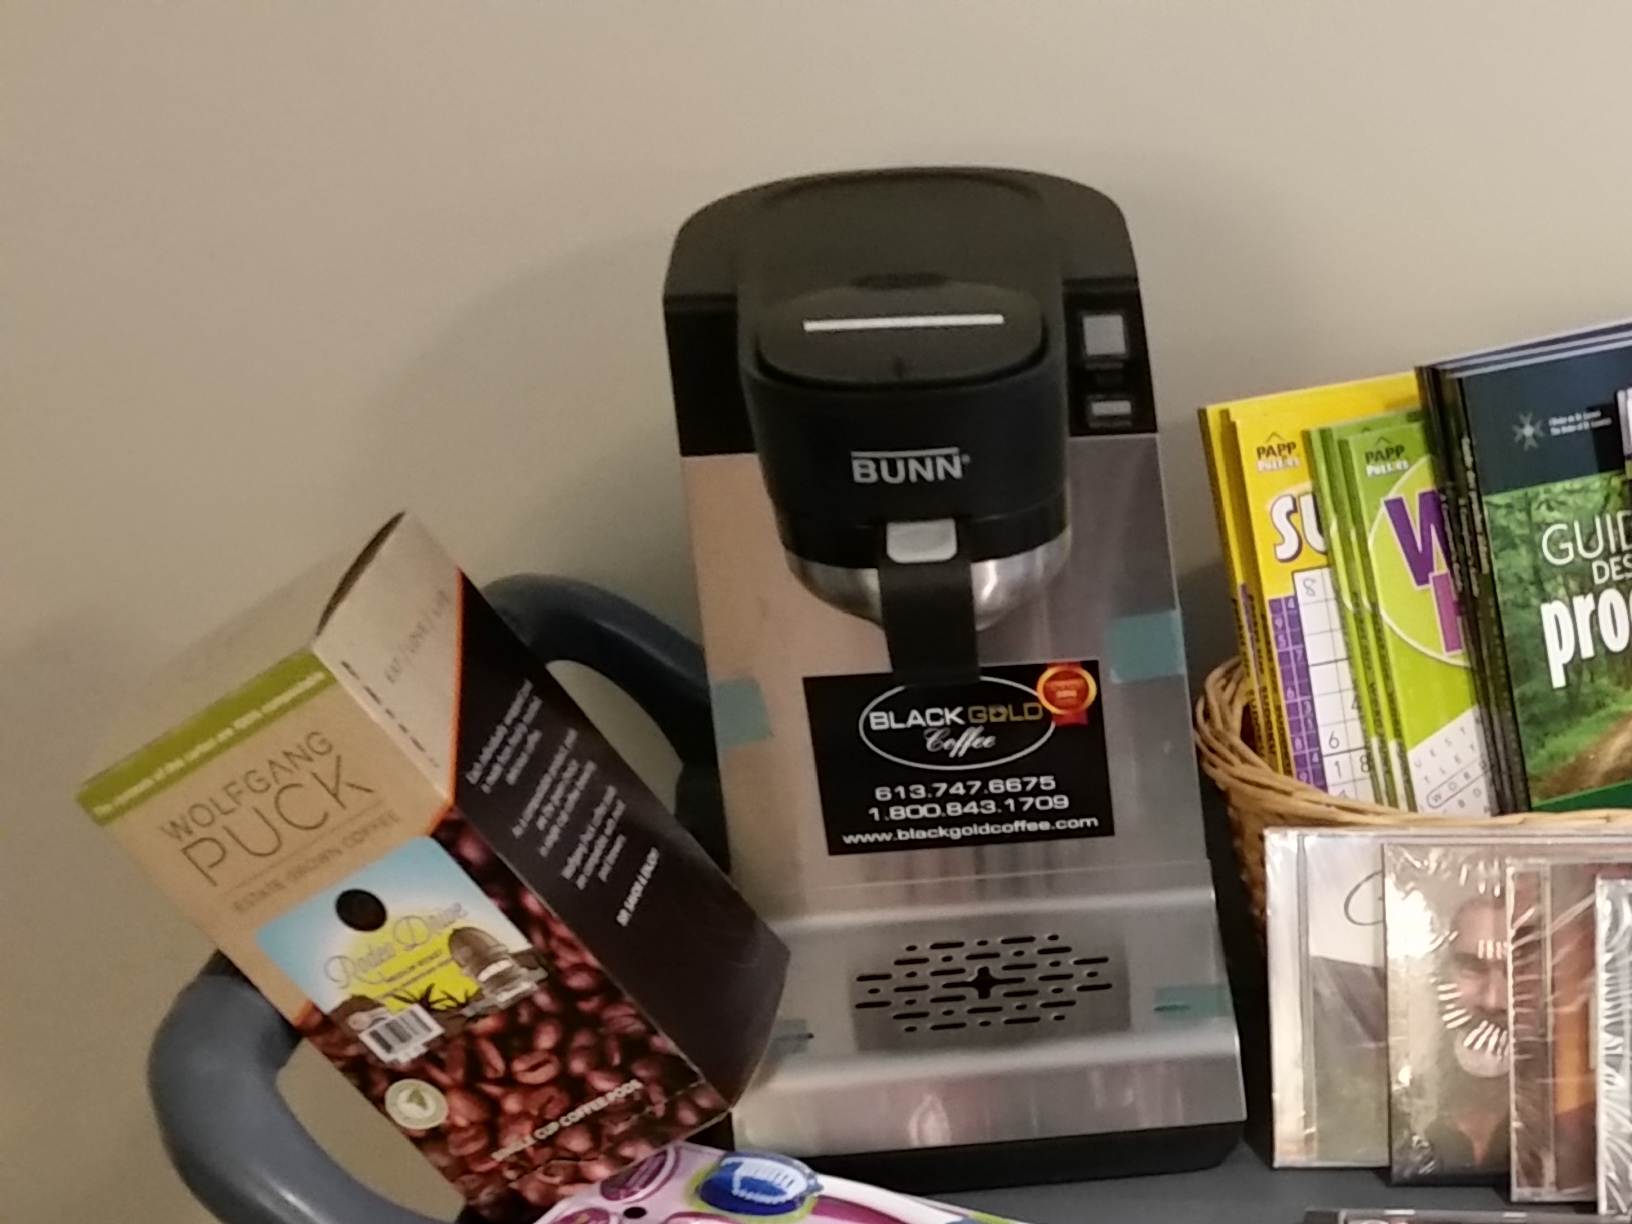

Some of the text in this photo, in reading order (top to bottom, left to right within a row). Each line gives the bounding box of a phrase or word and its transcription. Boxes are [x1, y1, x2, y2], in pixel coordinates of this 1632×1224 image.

[1256, 442, 1297, 460] PAPP
[1365, 445, 1405, 463] PAPP
[851, 454, 963, 484] BUNN
[869, 702, 1044, 730] BLACK GOLD
[923, 725, 997, 758] Coffee
[160, 731, 333, 842] WOLFGANG
[875, 775, 1056, 801] 613.747.6675
[181, 755, 374, 887] PUCK
[868, 795, 1070, 822] 1.800.843.1709
[842, 816, 1099, 845] www.blackgoldcoffee.com
[533, 1121, 560, 1140] CUP
[559, 1096, 609, 1128] COFFEE
